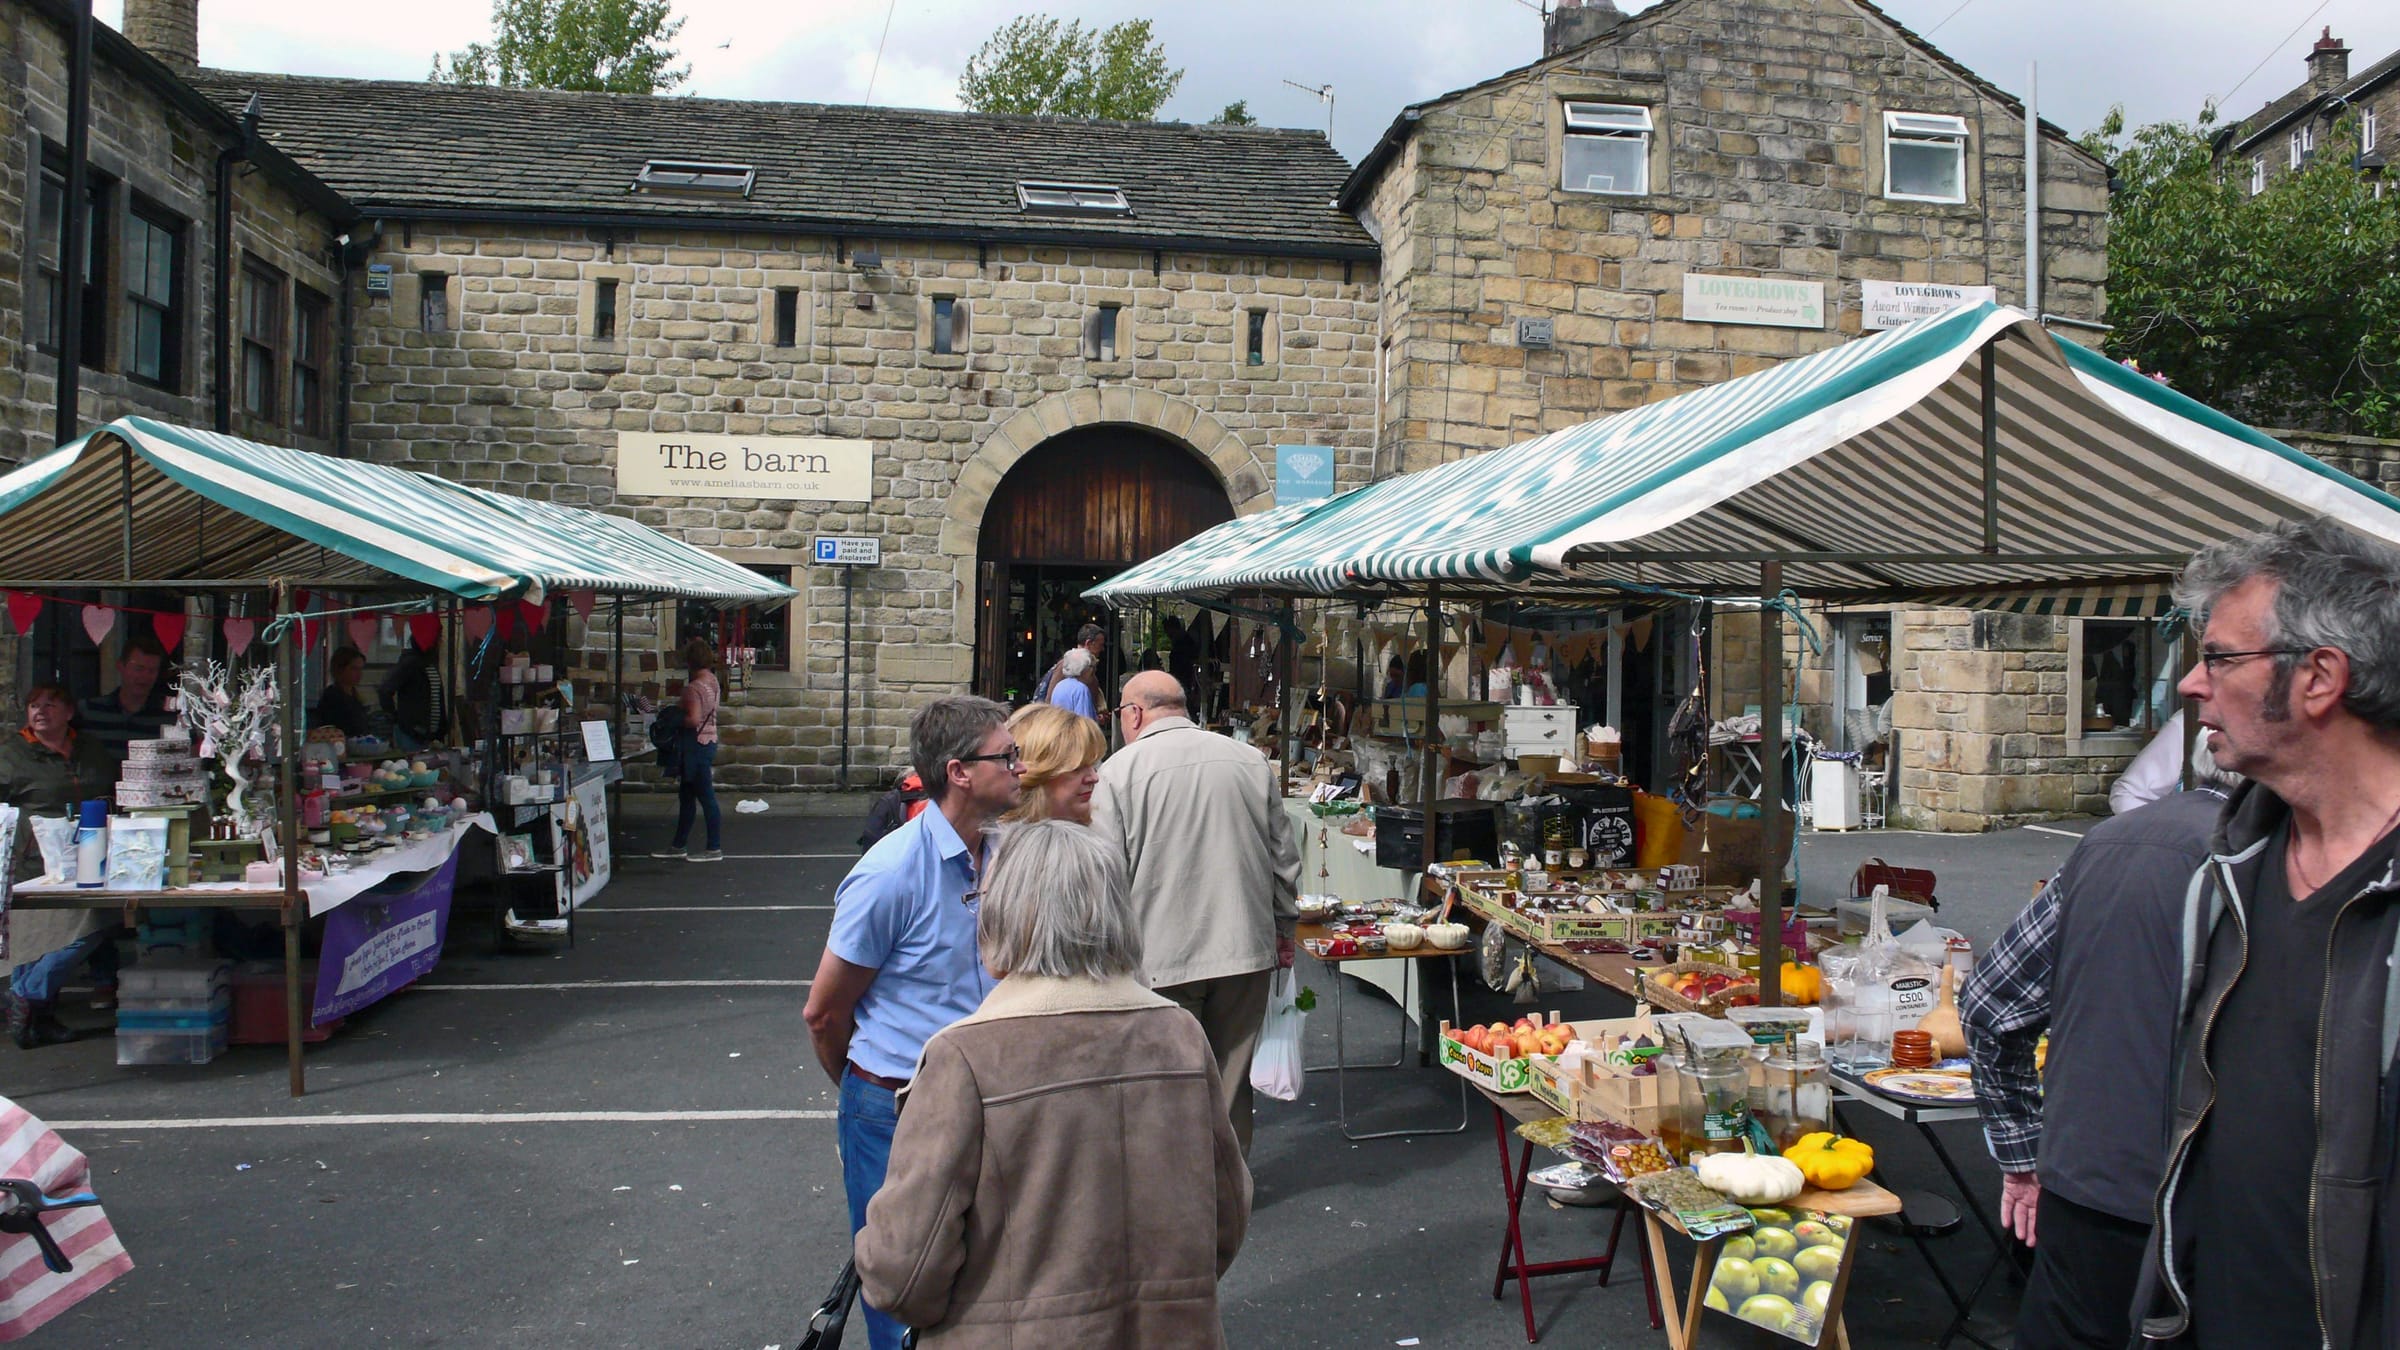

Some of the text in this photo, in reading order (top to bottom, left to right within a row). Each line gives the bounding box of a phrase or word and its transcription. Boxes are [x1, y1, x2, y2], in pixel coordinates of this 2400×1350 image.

[1699, 279, 1808, 300] LOVEGROWS
[1895, 286, 1961, 299] LOVEGROWS
[1871, 299, 1901, 312] Award
[659, 444, 831, 473] The barn
[670, 478, 820, 490] www.ameliasbarn.co.uk
[821, 542, 834, 558] P
[842, 547, 858, 555] paid
[1860, 632, 1884, 643] Service
[1899, 991, 1923, 1003] C500
[1895, 1002, 1928, 1011] CONTAINERS
[1807, 1211, 1843, 1229] Olives
